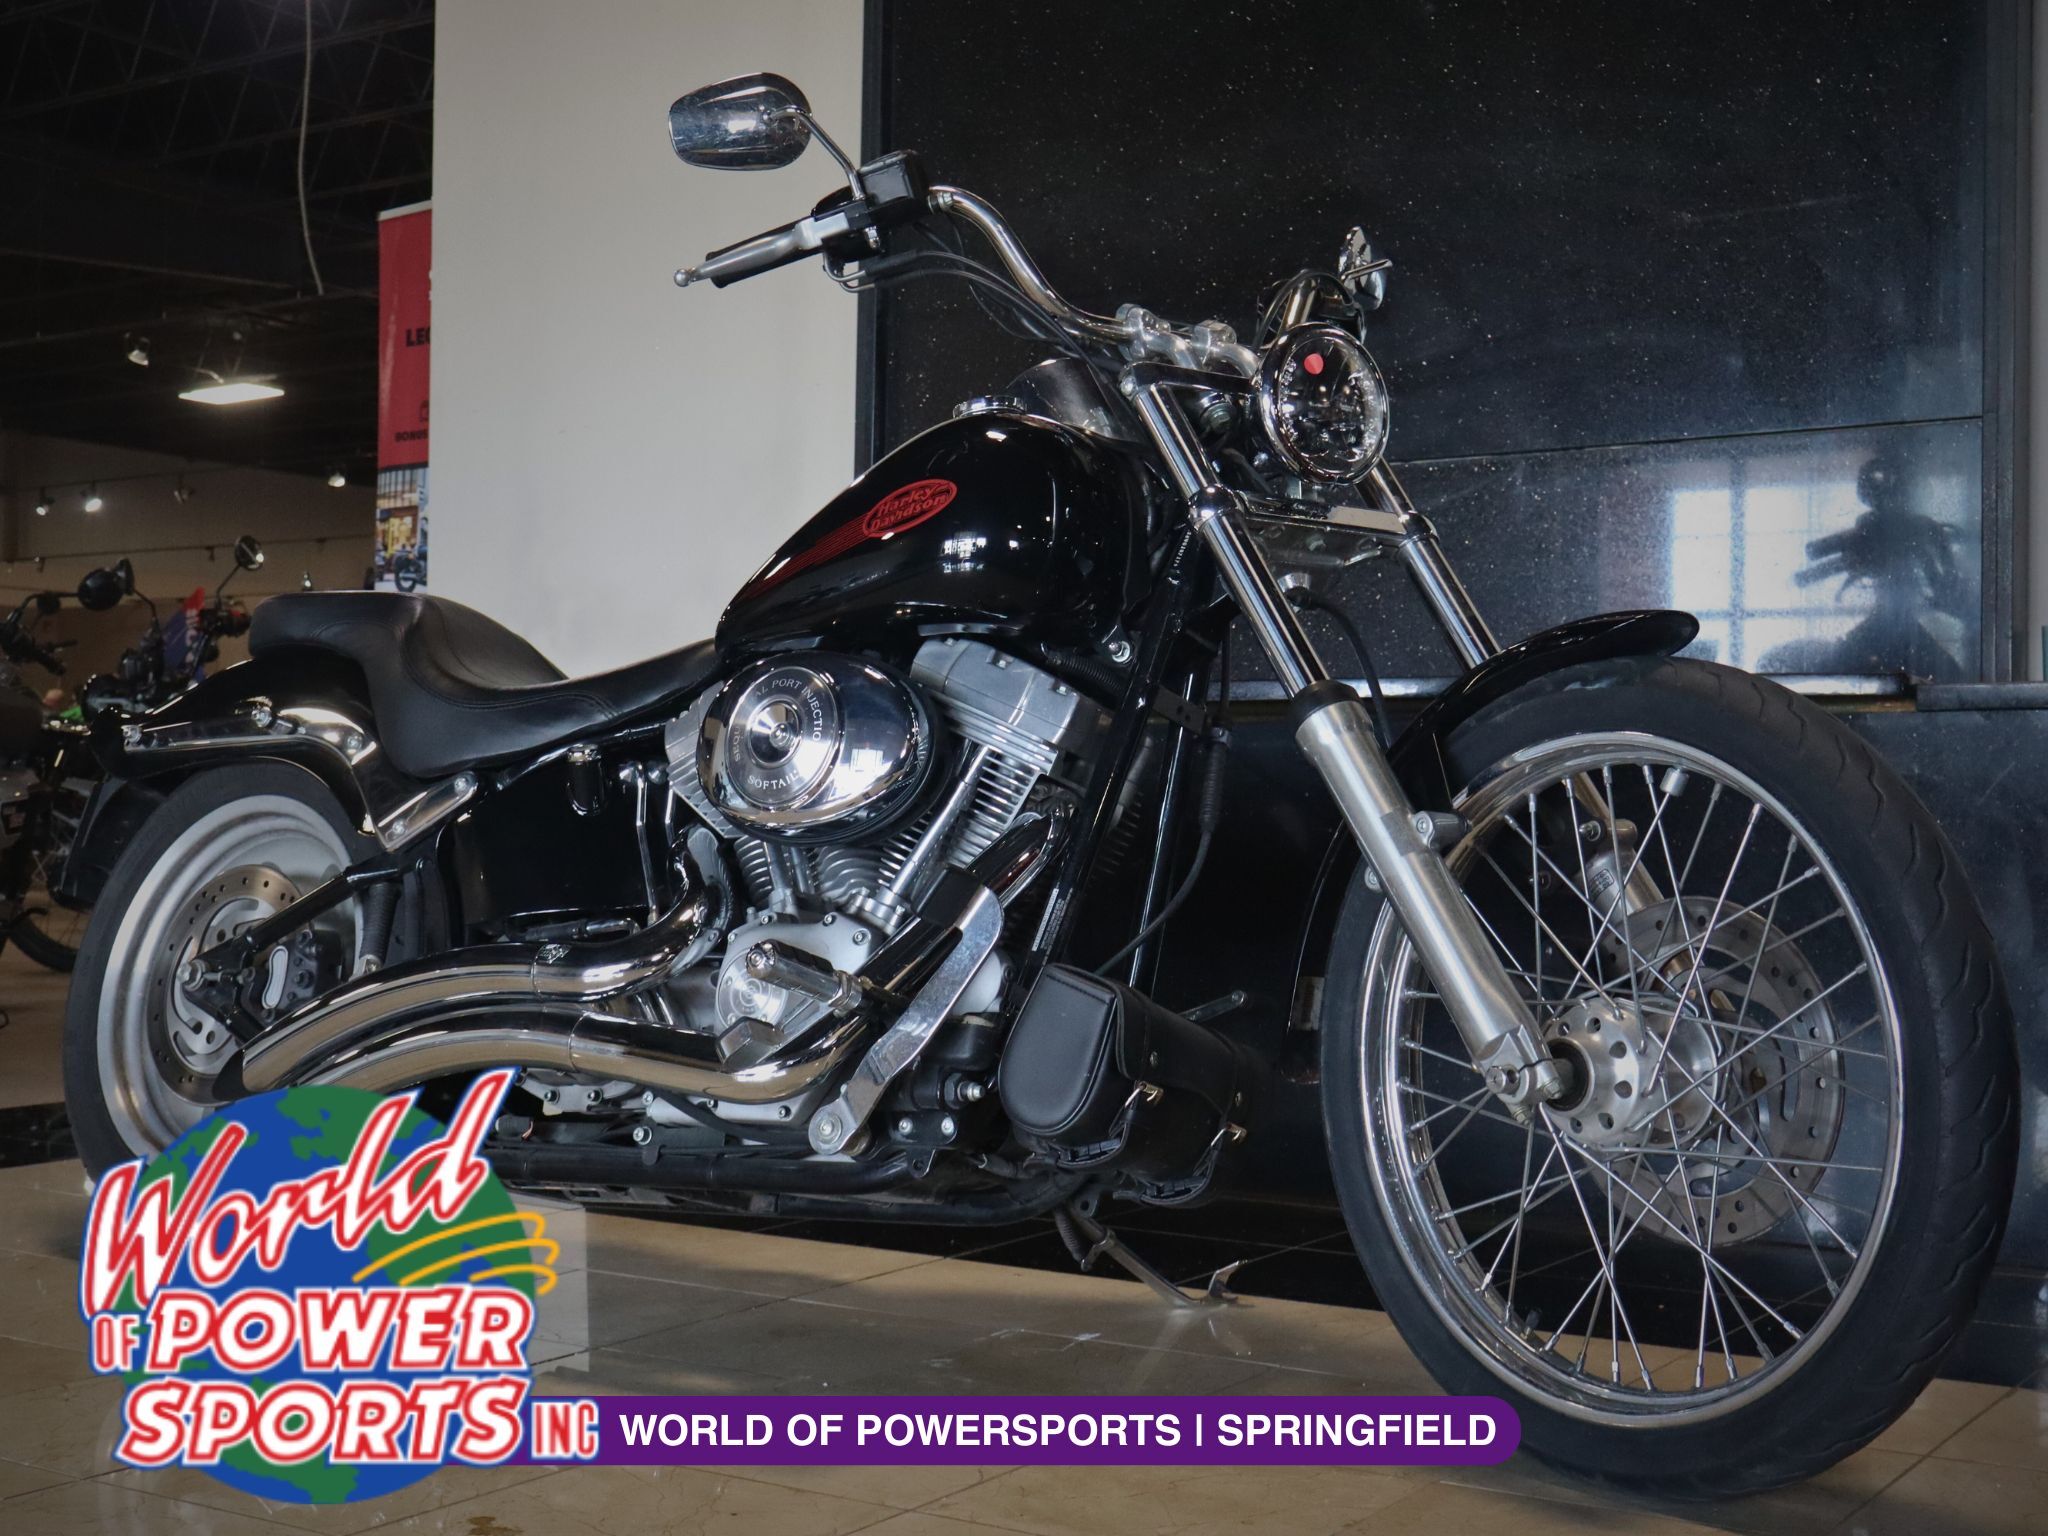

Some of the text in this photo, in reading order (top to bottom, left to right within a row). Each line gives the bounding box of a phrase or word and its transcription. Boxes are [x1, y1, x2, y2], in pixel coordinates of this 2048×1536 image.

[772, 678, 802, 690] PORT
[801, 686, 823, 742] INJECTIO
[747, 770, 799, 790] SOFTAIL
